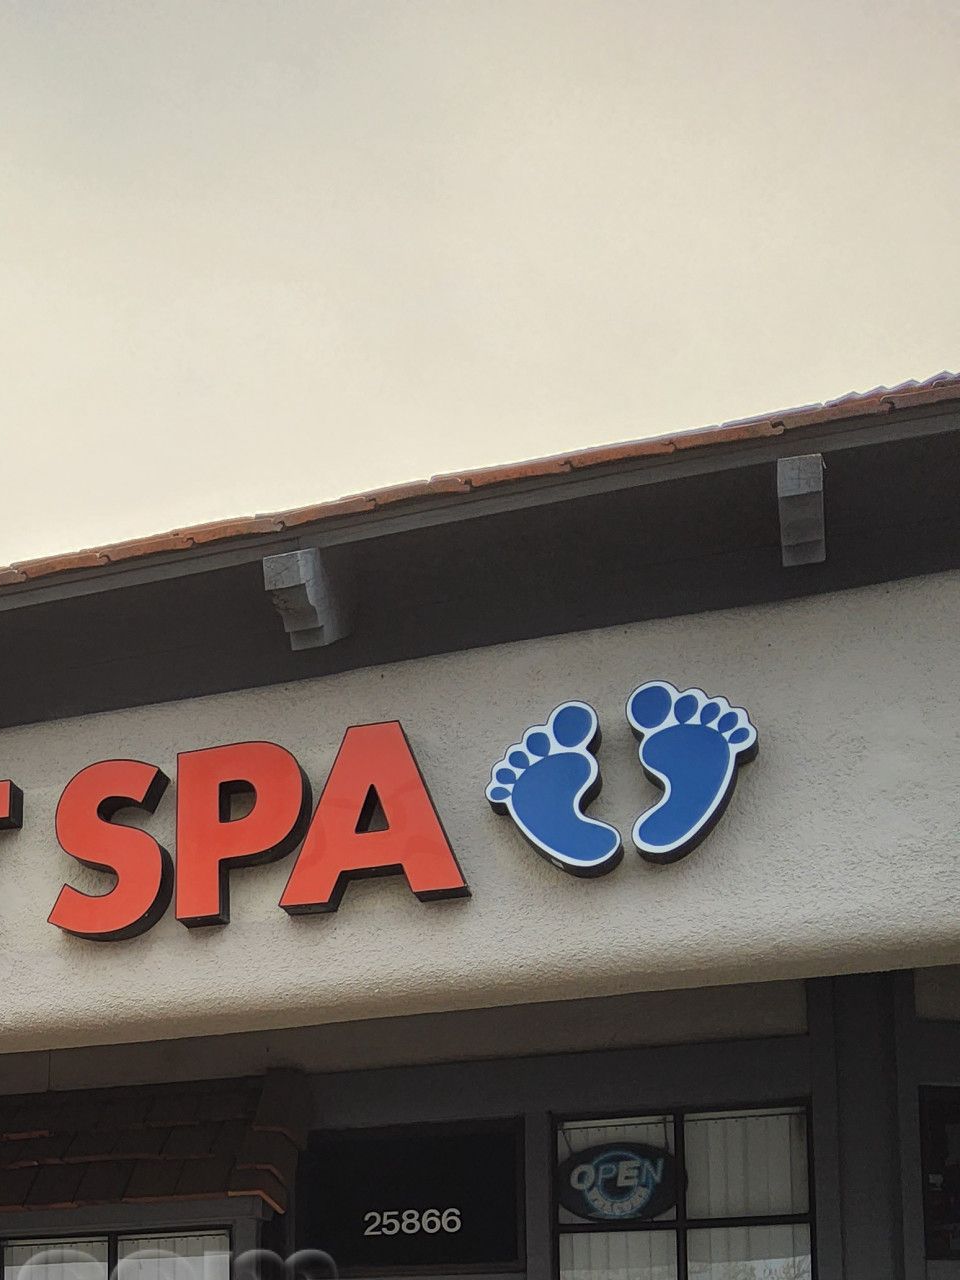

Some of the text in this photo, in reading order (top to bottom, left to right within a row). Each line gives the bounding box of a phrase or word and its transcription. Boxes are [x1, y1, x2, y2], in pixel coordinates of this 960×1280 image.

[47, 719, 471, 942] SPA
[570, 1158, 665, 1190] OPEN
[363, 1208, 462, 1236] 25866
